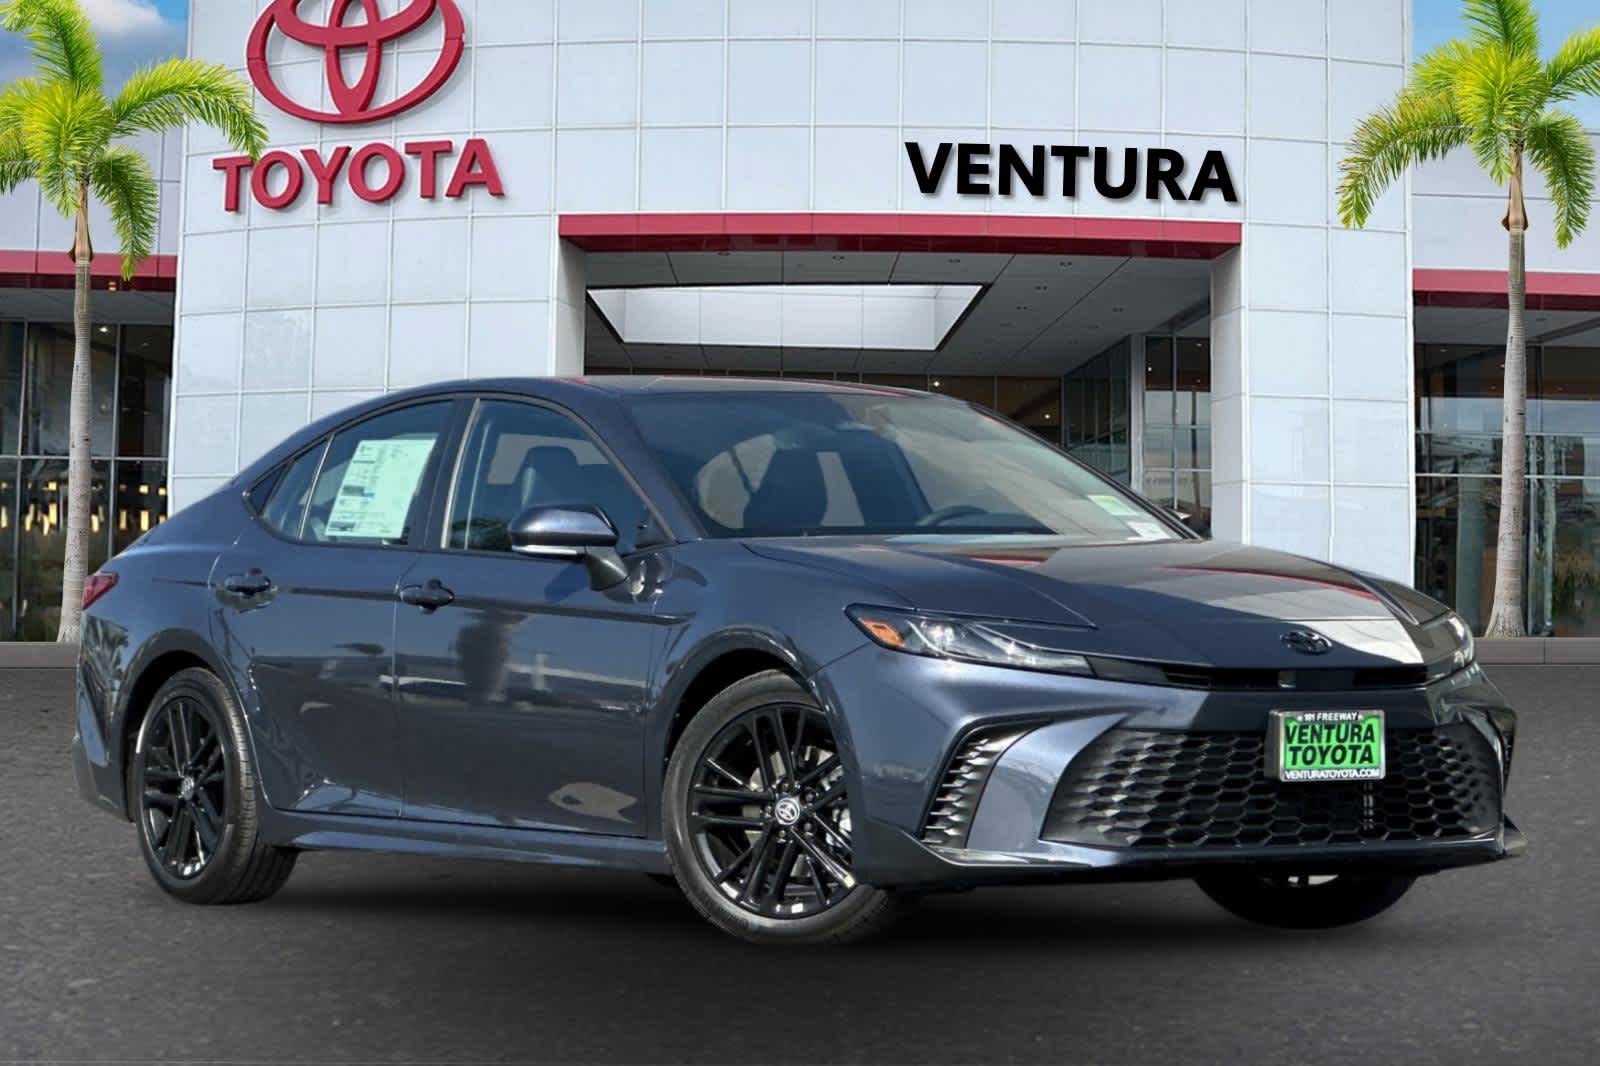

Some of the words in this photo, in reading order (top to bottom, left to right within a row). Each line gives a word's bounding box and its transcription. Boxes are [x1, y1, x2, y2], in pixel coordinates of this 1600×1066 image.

[212, 138, 504, 212] TOYOTA
[905, 141, 1239, 203] VENTURA
[1316, 712, 1358, 721] FREEWAY
[1284, 723, 1376, 744] VENTURA
[1289, 744, 1374, 766] TOYOTA
[1284, 768, 1380, 780] VENTURATOYOTA.COM
